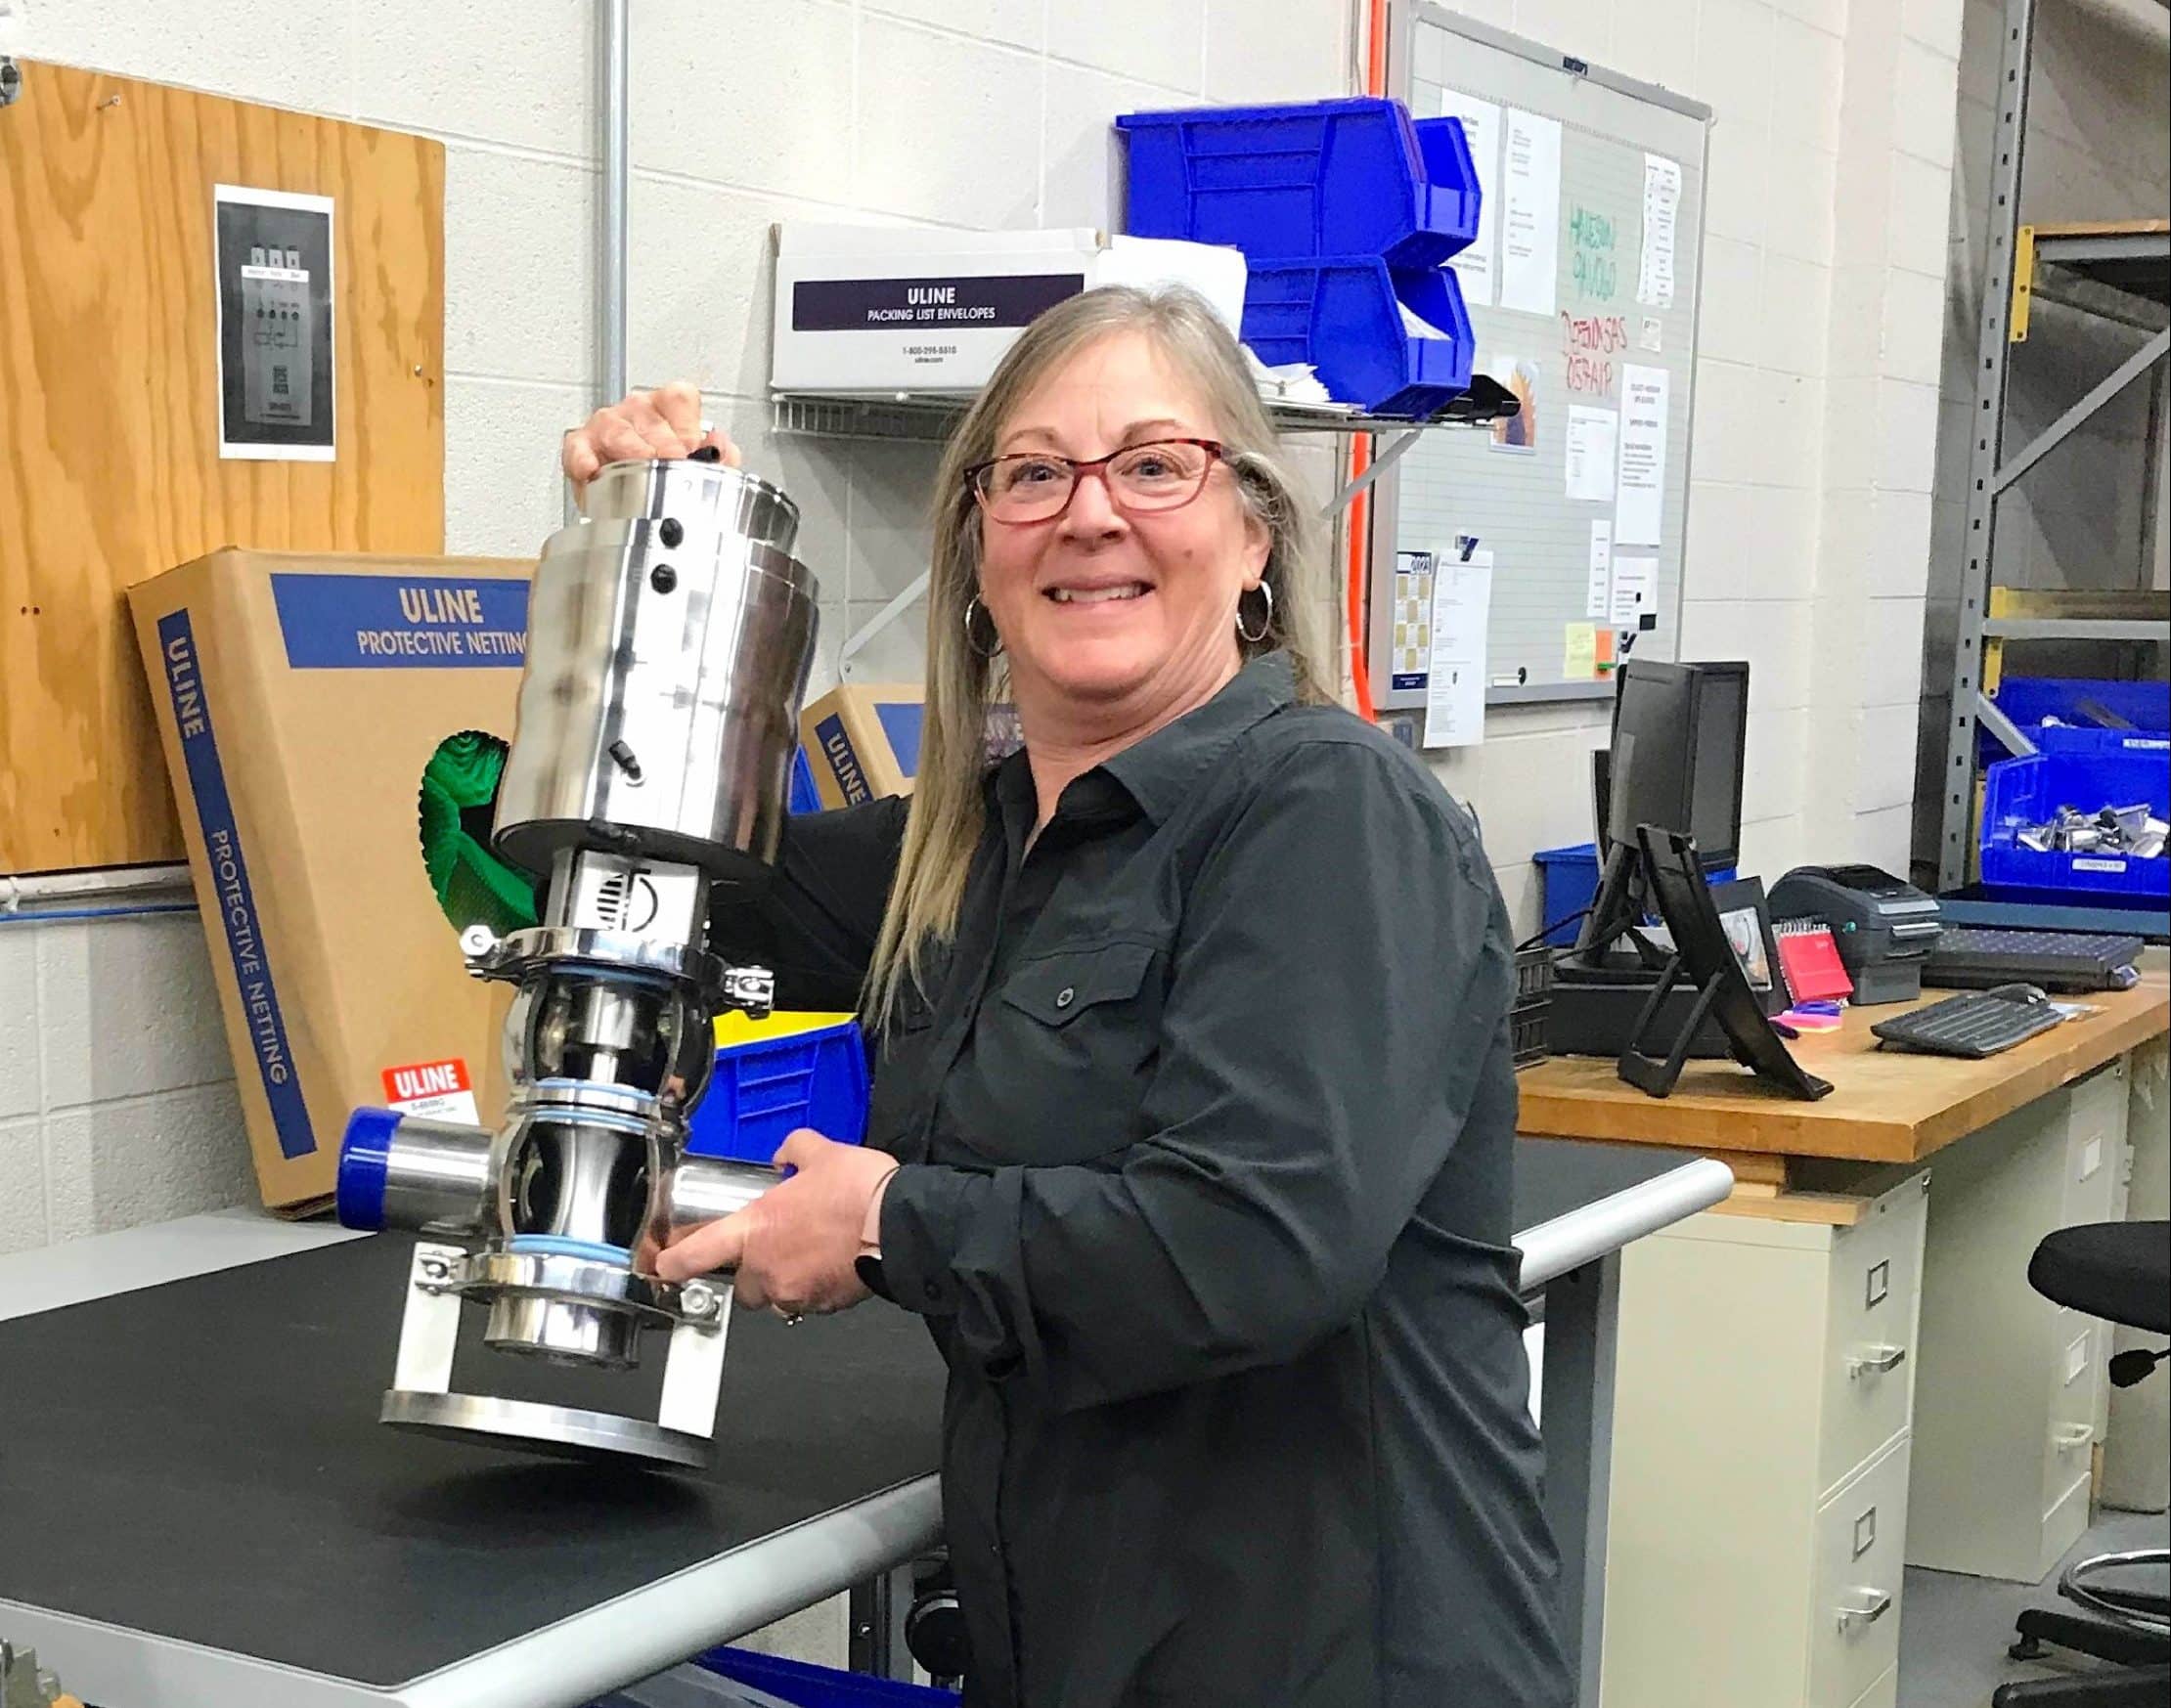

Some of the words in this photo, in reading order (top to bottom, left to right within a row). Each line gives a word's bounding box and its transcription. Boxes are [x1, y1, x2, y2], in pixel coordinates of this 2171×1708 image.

[908, 286, 956, 305] ULINE
[866, 308, 913, 322] PACKING
[916, 308, 935, 321] LIST
[937, 307, 996, 320] ENVELOPES
[399, 588, 484, 624] ULINE
[357, 631, 464, 655] PROTECTIVE
[169, 636, 204, 738] ULINE
[828, 732, 867, 806] ULINE
[211, 830, 261, 975] PROTECTIVE
[247, 982, 288, 1085] NETTING
[394, 1064, 459, 1098] ULINE
